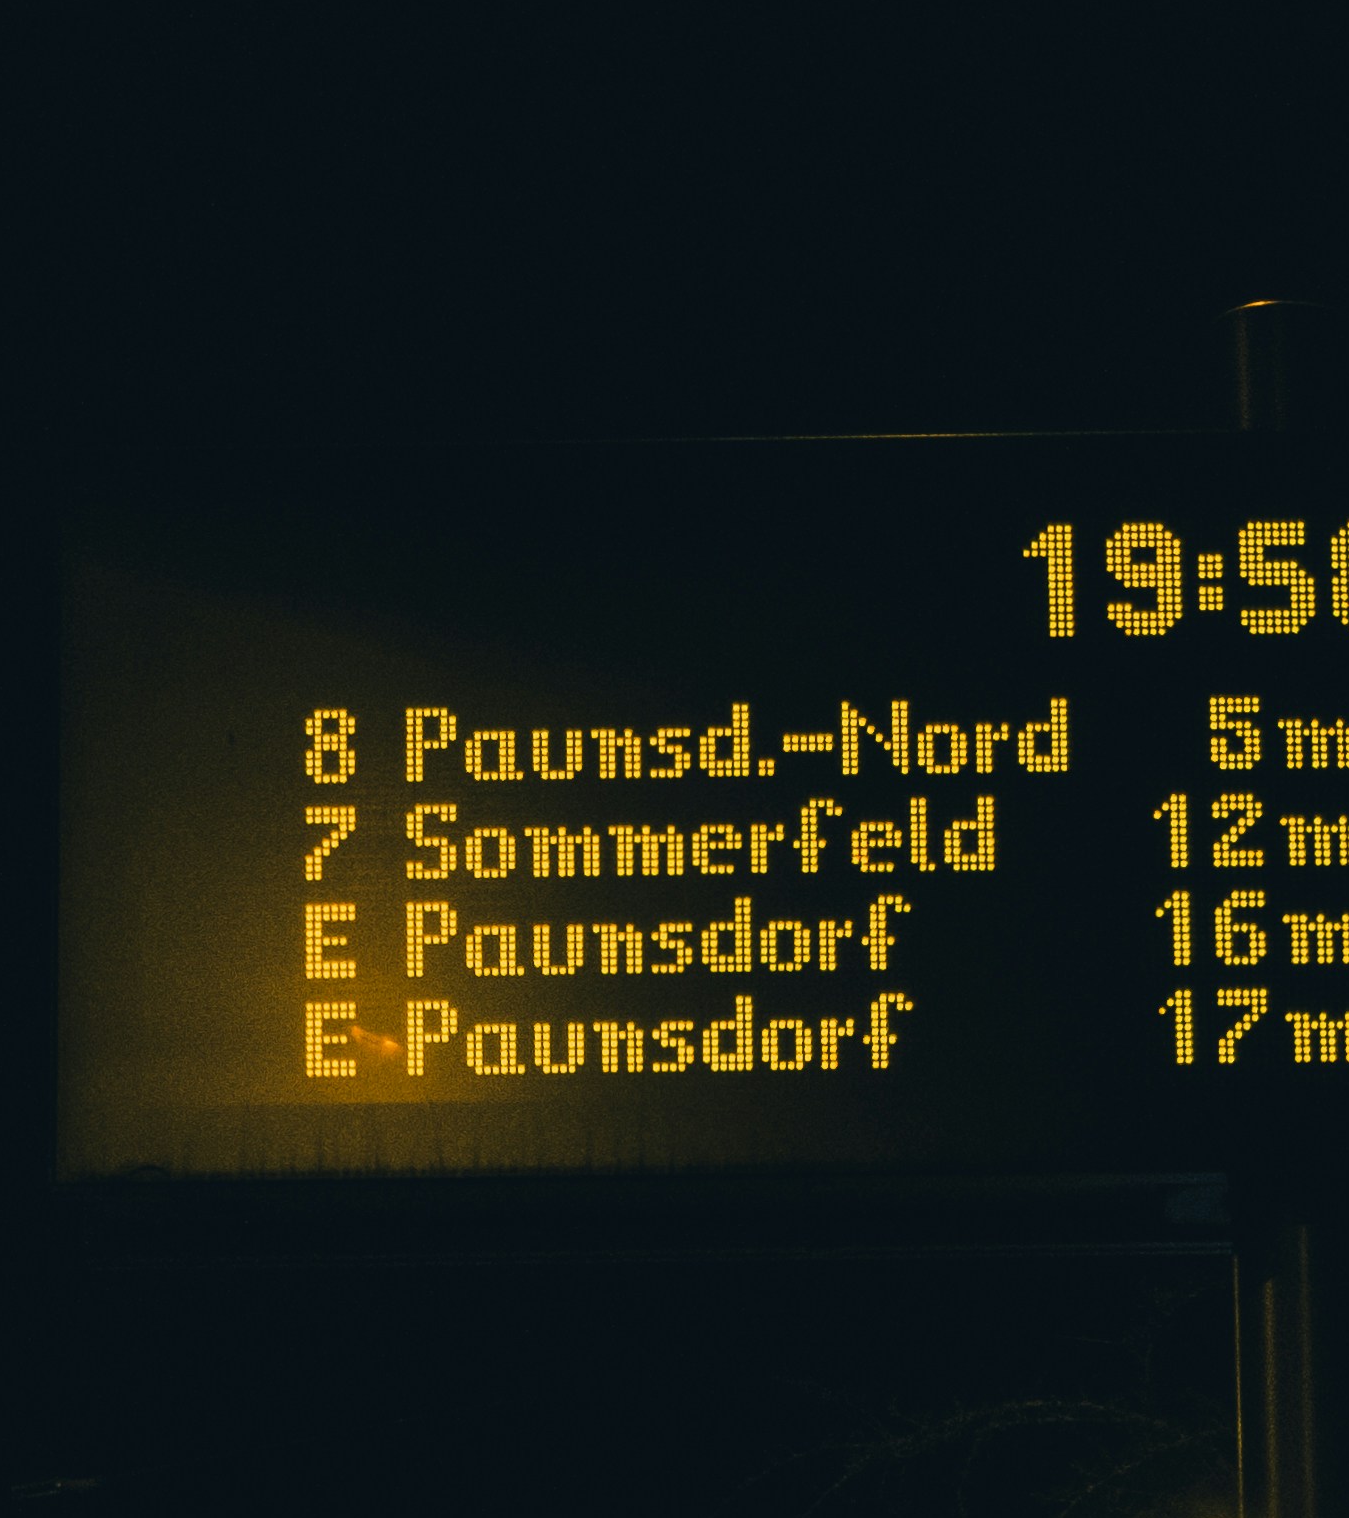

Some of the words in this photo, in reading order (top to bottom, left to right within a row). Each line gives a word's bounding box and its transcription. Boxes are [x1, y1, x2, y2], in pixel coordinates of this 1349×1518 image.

[305, 708, 357, 785] 8
[404, 699, 1069, 782] Paunsd.-Nord
[305, 805, 357, 882] 7
[404, 795, 996, 881] Sommerfeld
[305, 902, 357, 980] E
[404, 894, 912, 979] Paunsdorf
[305, 999, 357, 1079] E
[404, 992, 914, 1079] Paunsdorf
